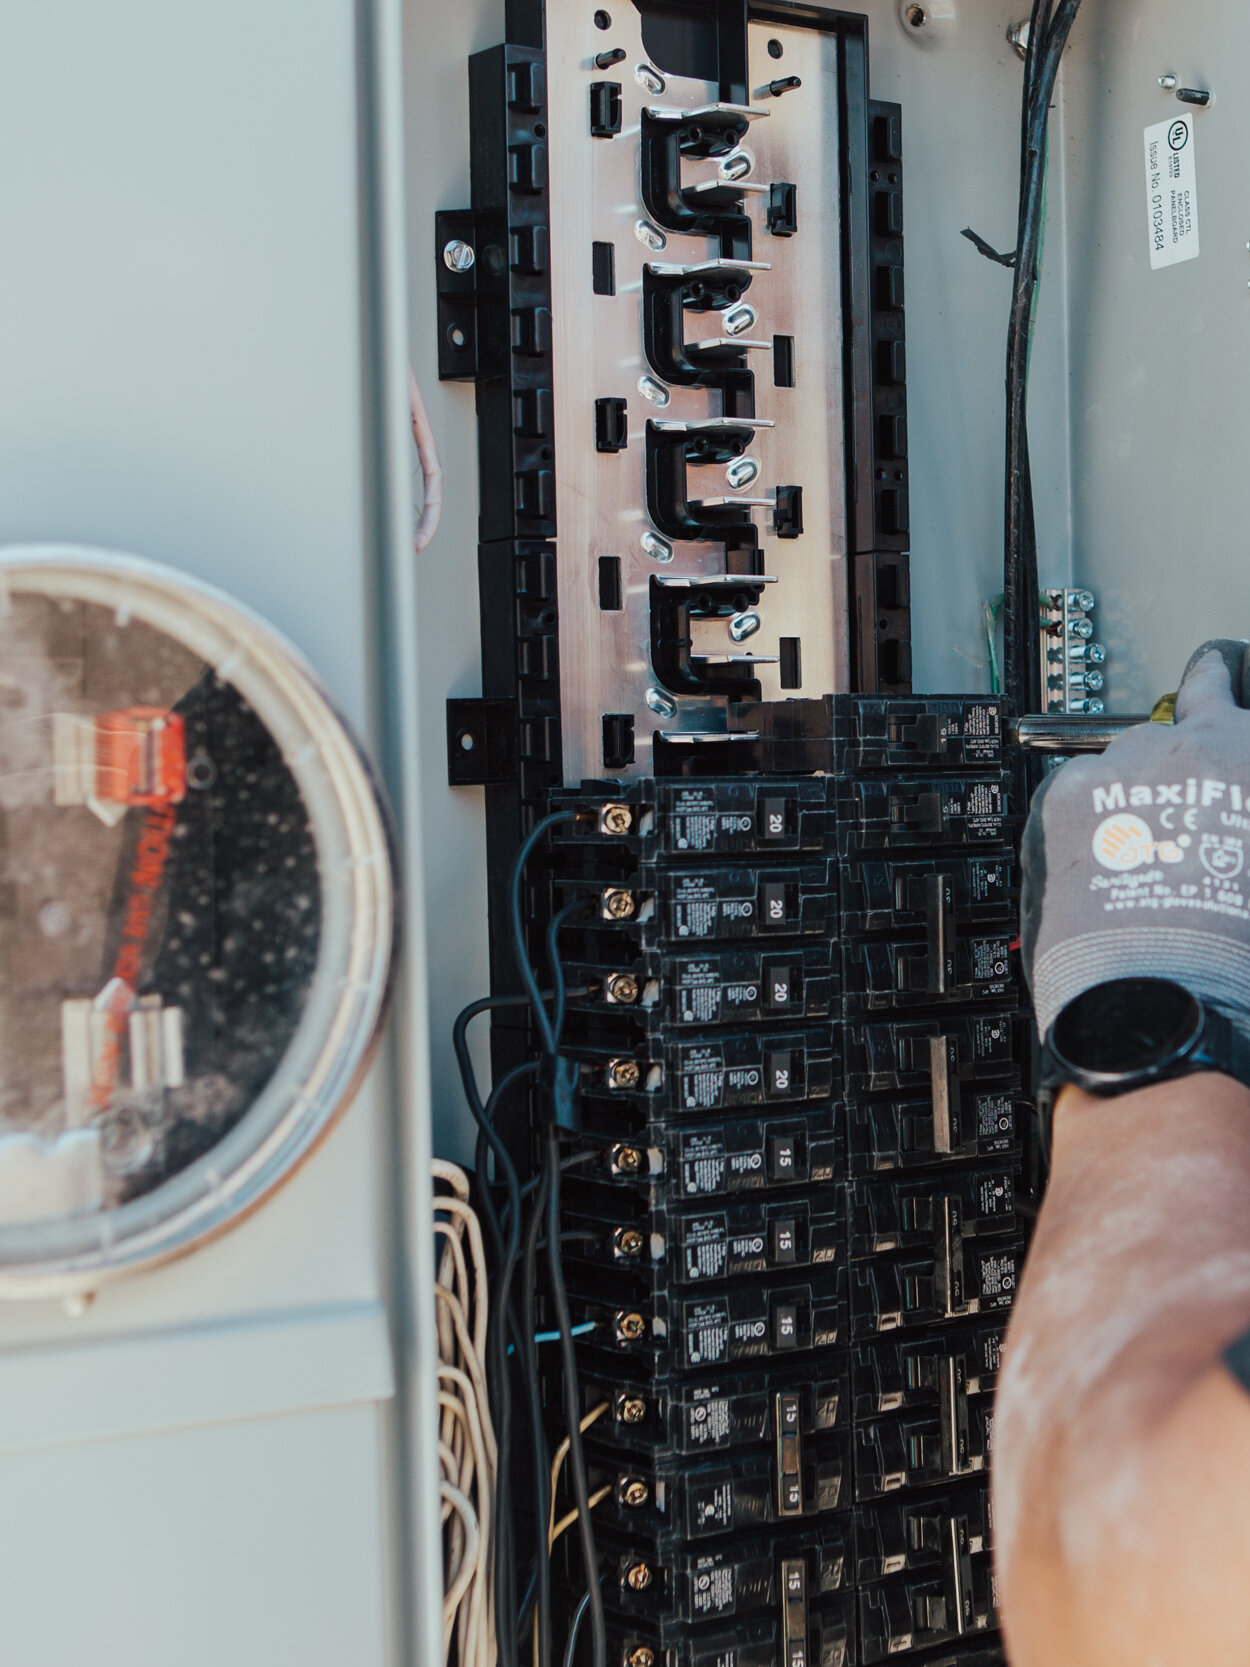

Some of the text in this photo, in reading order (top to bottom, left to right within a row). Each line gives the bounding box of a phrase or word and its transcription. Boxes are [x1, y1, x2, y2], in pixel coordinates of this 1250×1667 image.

[1173, 127, 1183, 144] UL
[1150, 141, 1164, 250] Issue No. 0103484
[769, 814, 782, 833] 20
[1110, 886, 1149, 900] Patent
[1180, 884, 1198, 896] EP
[770, 900, 782, 918] 20
[774, 983, 788, 1001] 20
[776, 1070, 788, 1088] 20
[779, 1148, 791, 1166] 15
[779, 1231, 792, 1249] 15
[781, 1317, 793, 1335] 15
[786, 1404, 797, 1422] 15
[789, 1484, 799, 1503] 15
[788, 1572, 800, 1590] 15
[792, 1651, 803, 1667] 15
